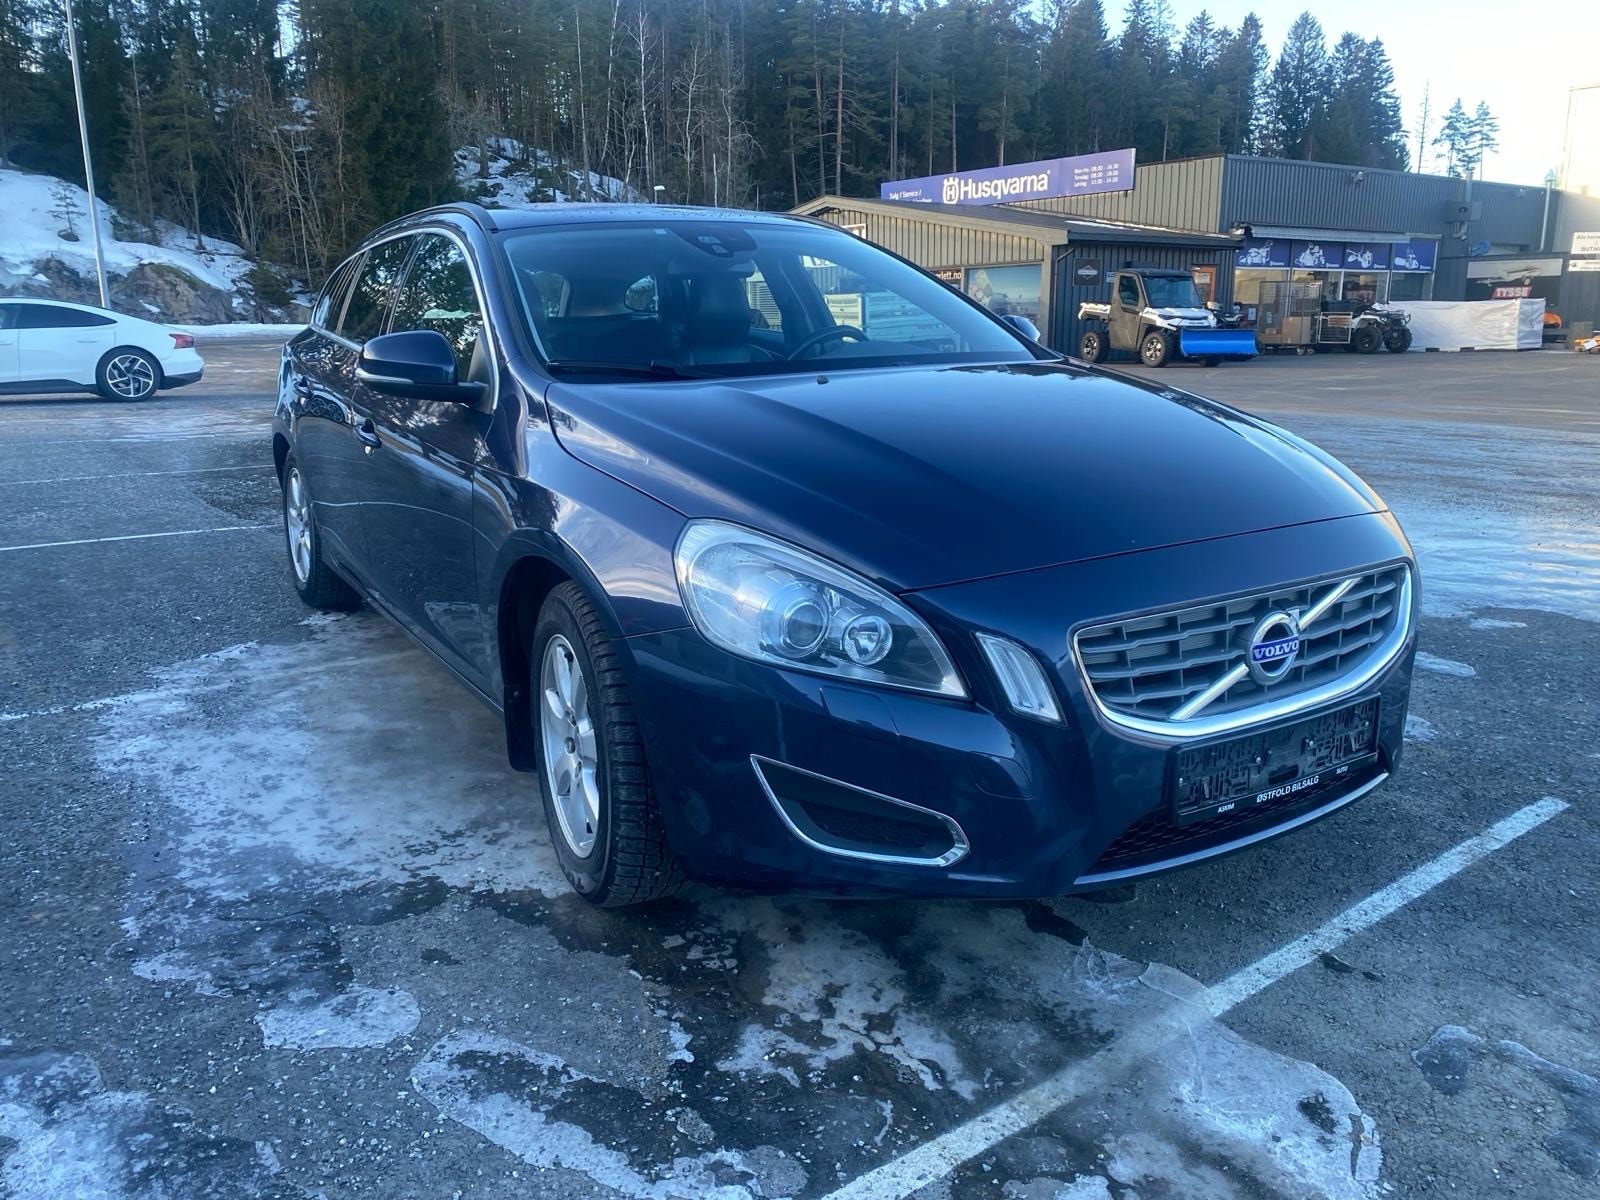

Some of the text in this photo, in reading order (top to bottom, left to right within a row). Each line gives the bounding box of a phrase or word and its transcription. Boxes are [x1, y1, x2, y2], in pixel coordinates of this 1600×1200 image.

[960, 174, 1048, 200] Husqvarna
[1495, 287, 1530, 297] TYSSE
[1254, 640, 1299, 659] VOLVO
[1257, 775, 1319, 803] ØSTFOLD BILSALG
